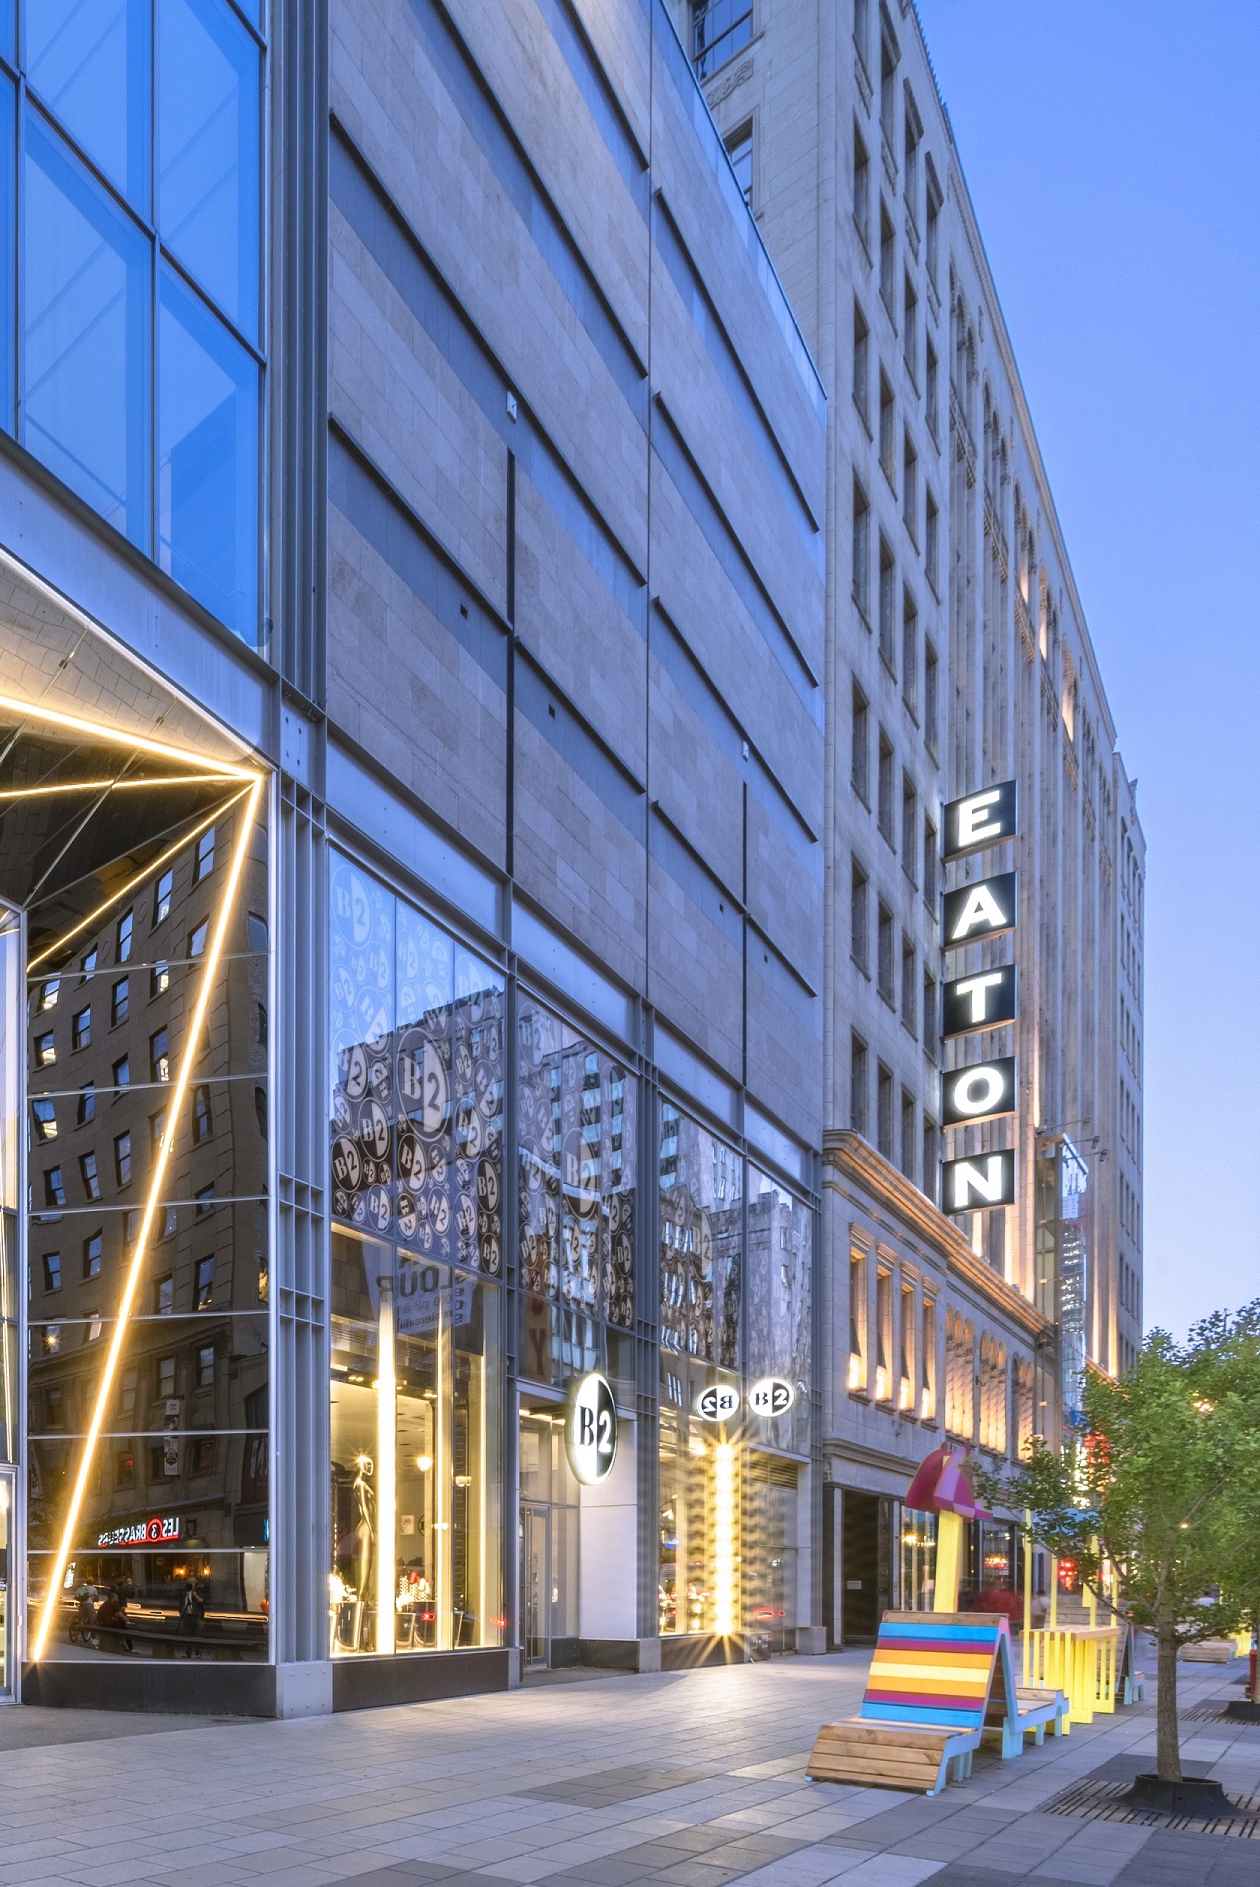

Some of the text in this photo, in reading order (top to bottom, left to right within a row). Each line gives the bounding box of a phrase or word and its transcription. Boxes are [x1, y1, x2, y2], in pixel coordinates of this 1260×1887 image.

[336, 884, 367, 927] B2
[951, 790, 1006, 1206] EATON
[521, 1021, 541, 1052] B2
[336, 1044, 363, 1088] B2
[456, 1055, 472, 1076] B2
[402, 1055, 442, 1112] B2
[361, 1118, 385, 1142] B2
[459, 1111, 478, 1150] B2
[333, 1150, 358, 1180] B2
[363, 1161, 374, 1178] B2
[401, 1143, 422, 1182] B2
[521, 1155, 540, 1182] B2
[566, 1152, 592, 1191] B2
[477, 1176, 496, 1198] B2
[351, 1196, 364, 1220] B2
[369, 1194, 388, 1221] B2
[401, 1196, 413, 1232] B2
[430, 1195, 447, 1227] B2
[456, 1204, 475, 1236] B2
[538, 1206, 556, 1227] B2
[419, 1225, 432, 1244] B2
[520, 1234, 537, 1260] B2
[692, 1226, 711, 1261] B2
[483, 1243, 498, 1266] B2
[617, 1247, 631, 1262] B2
[603, 1270, 616, 1292] B2
[621, 1301, 632, 1321] B2
[755, 1389, 788, 1406] B2
[579, 1405, 612, 1453] B2
